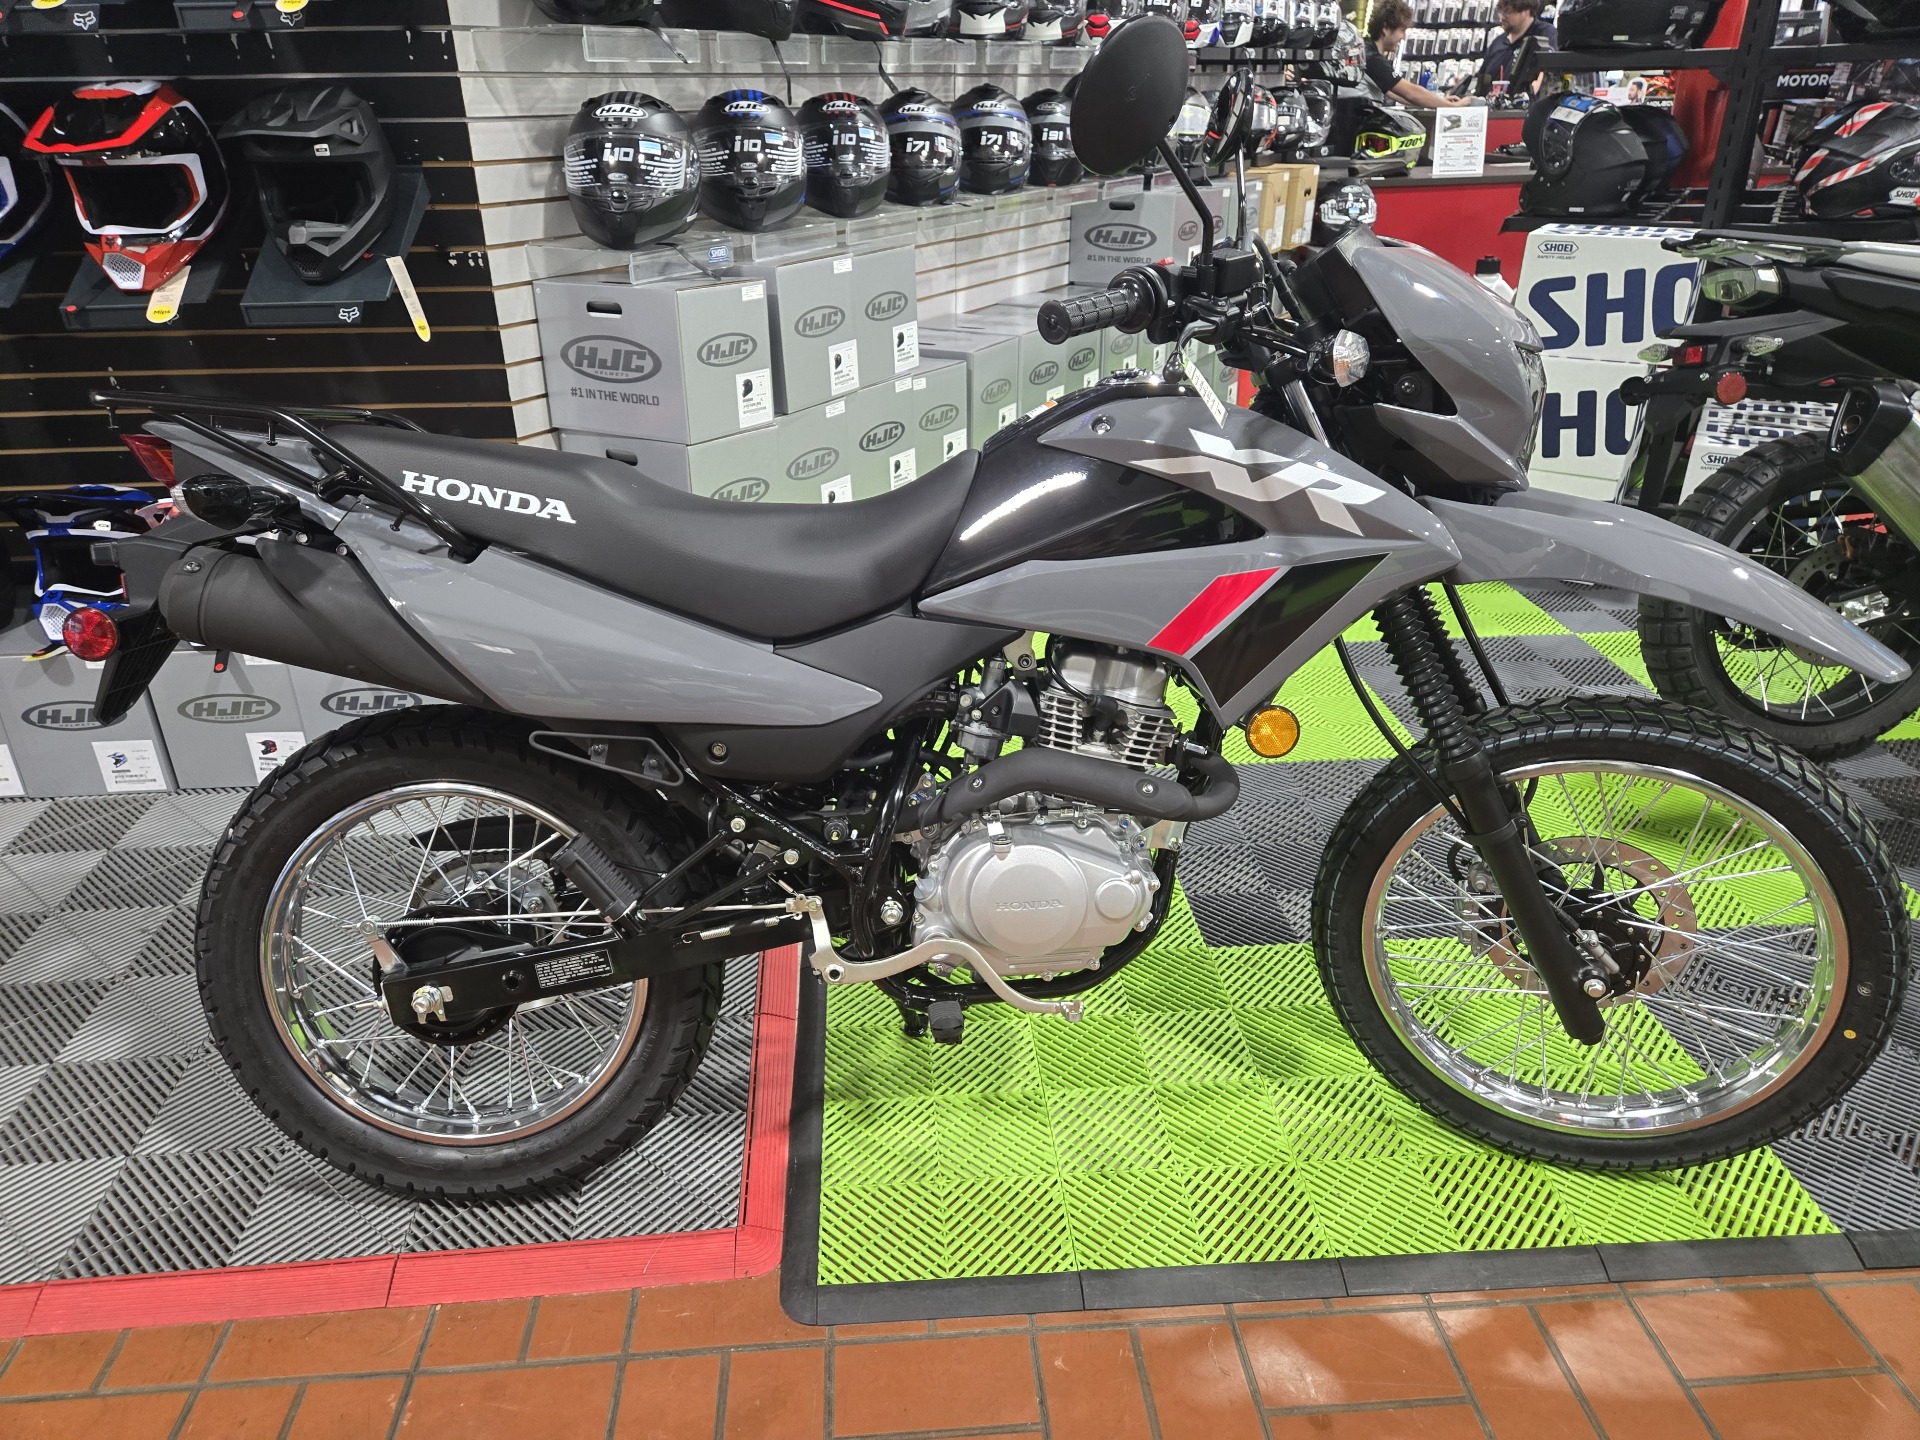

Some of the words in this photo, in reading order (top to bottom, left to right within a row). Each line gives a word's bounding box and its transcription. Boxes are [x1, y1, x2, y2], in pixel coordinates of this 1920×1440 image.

[600, 106, 639, 115] HJC
[728, 103, 763, 112] HJC
[826, 103, 857, 111] HJC
[901, 106, 932, 114] HJC
[833, 130, 857, 146] i10
[1042, 128, 1064, 141] i91
[602, 142, 635, 162] i10
[734, 135, 762, 152] i10
[1893, 190, 1918, 199] SHOEI
[1093, 230, 1148, 245] HJC
[1543, 242, 1573, 252] SHOEI
[1098, 254, 1106, 262] IN
[1106, 255, 1122, 263] THE
[1122, 256, 1152, 264] WORLD
[870, 295, 903, 317] HJC
[801, 310, 839, 333] HJC
[705, 338, 750, 361] HJC
[573, 345, 648, 374] HJC
[570, 386, 584, 398] #1
[585, 388, 596, 399] IN
[597, 389, 618, 402] THE
[619, 391, 660, 406] WORLD
[924, 407, 954, 428] HJC
[865, 424, 899, 449] HJC
[793, 449, 832, 477] HJC
[400, 470, 577, 525] HONDA
[192, 701, 266, 718] HJC
[334, 694, 408, 711] HJC
[995, 898, 1064, 912] HONDA
